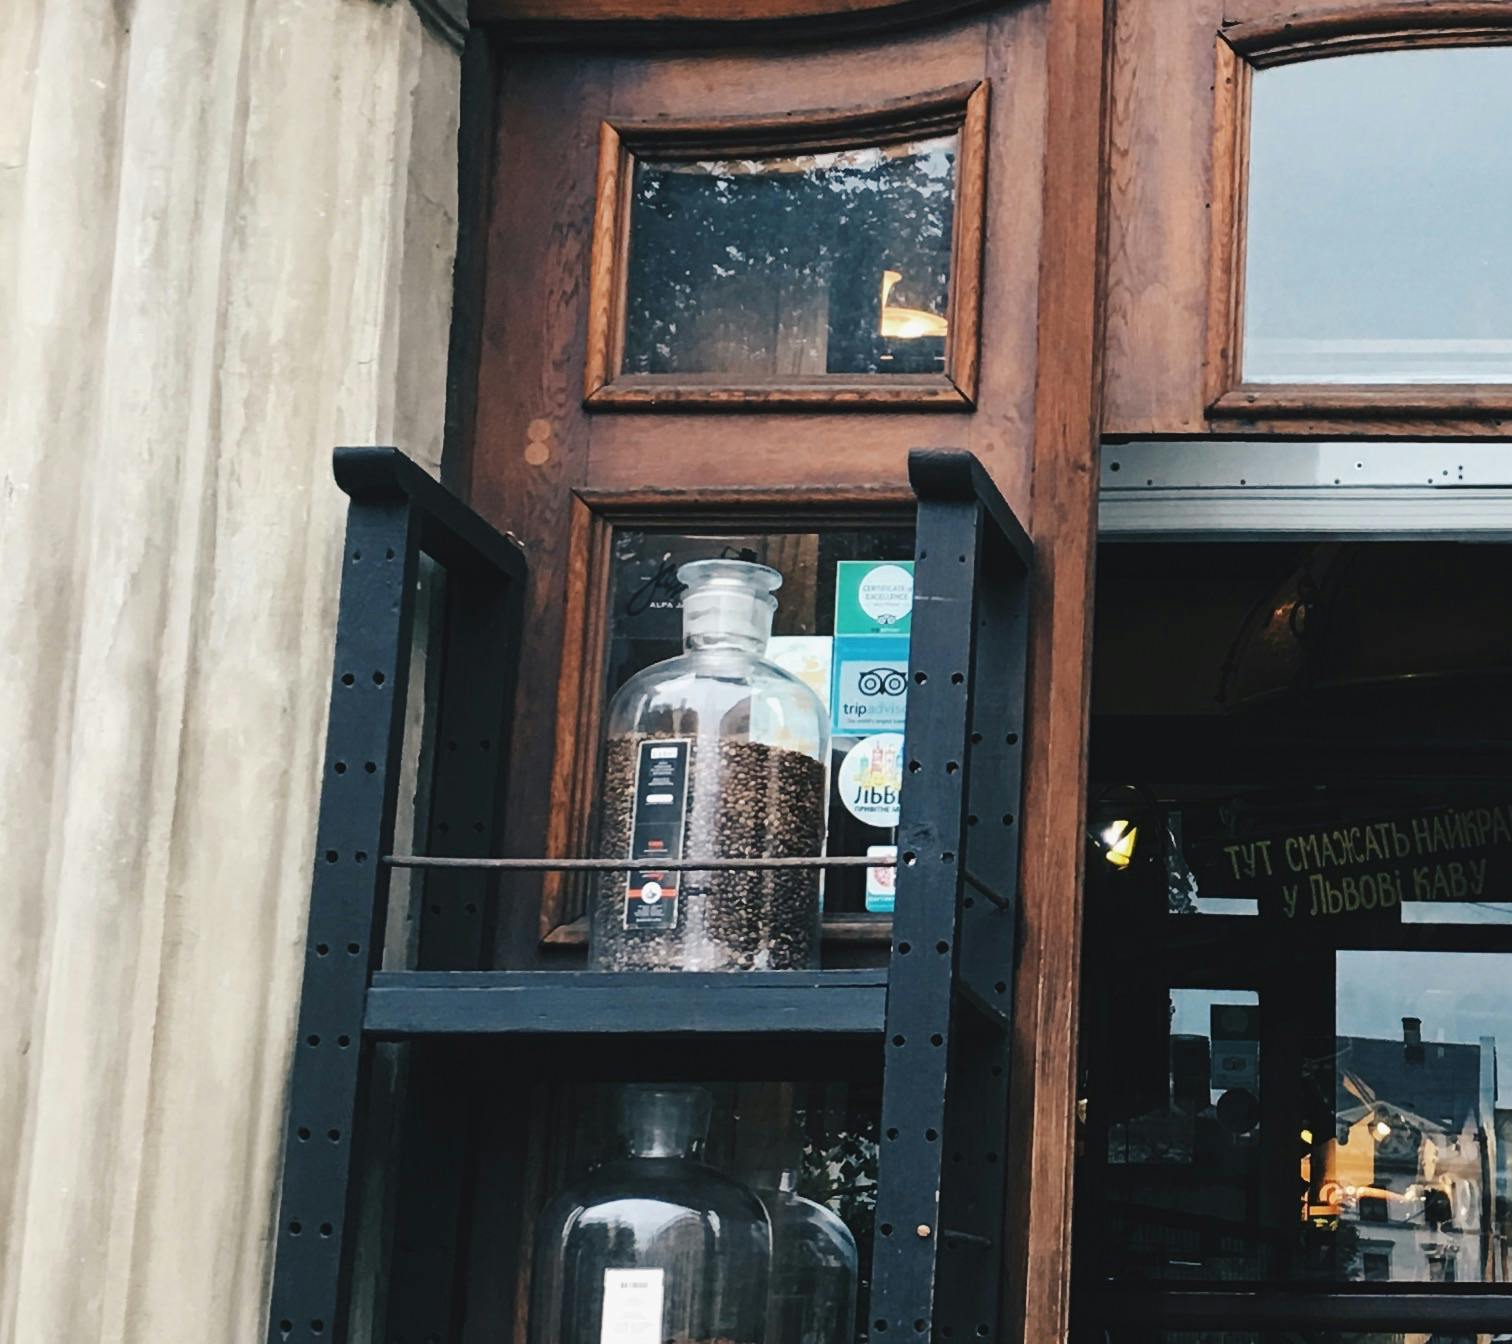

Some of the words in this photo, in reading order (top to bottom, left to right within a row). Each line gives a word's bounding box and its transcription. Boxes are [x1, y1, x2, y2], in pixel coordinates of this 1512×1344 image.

[1223, 841, 1273, 880] ТУТ
[1284, 820, 1411, 873] СМАЖАТЬ
[1412, 858, 1488, 901] КАВУ
